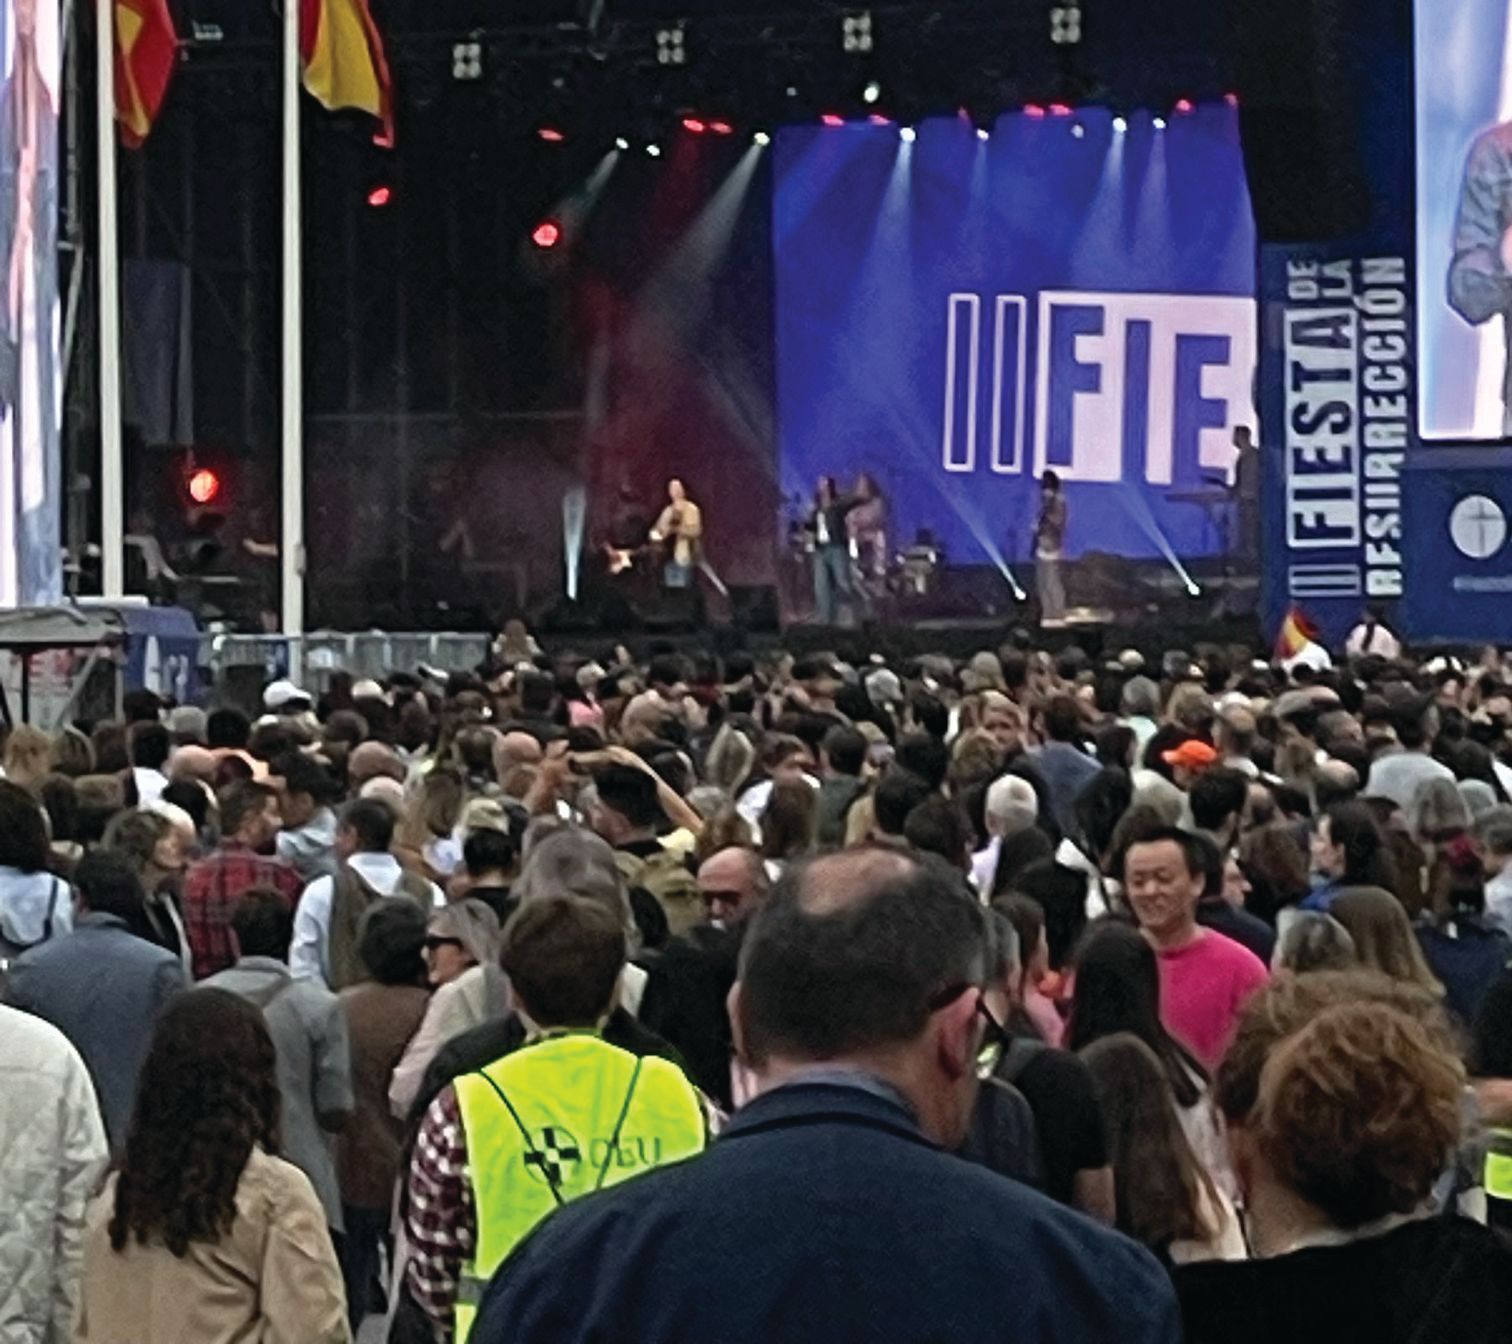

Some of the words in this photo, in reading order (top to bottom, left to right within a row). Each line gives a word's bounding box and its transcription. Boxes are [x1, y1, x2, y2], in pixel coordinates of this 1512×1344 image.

[1286, 259, 1319, 301] DE
[1321, 258, 1353, 299] LA
[1291, 313, 1354, 541] FIESTA
[1354, 257, 1408, 596] RESURRECCIÓN
